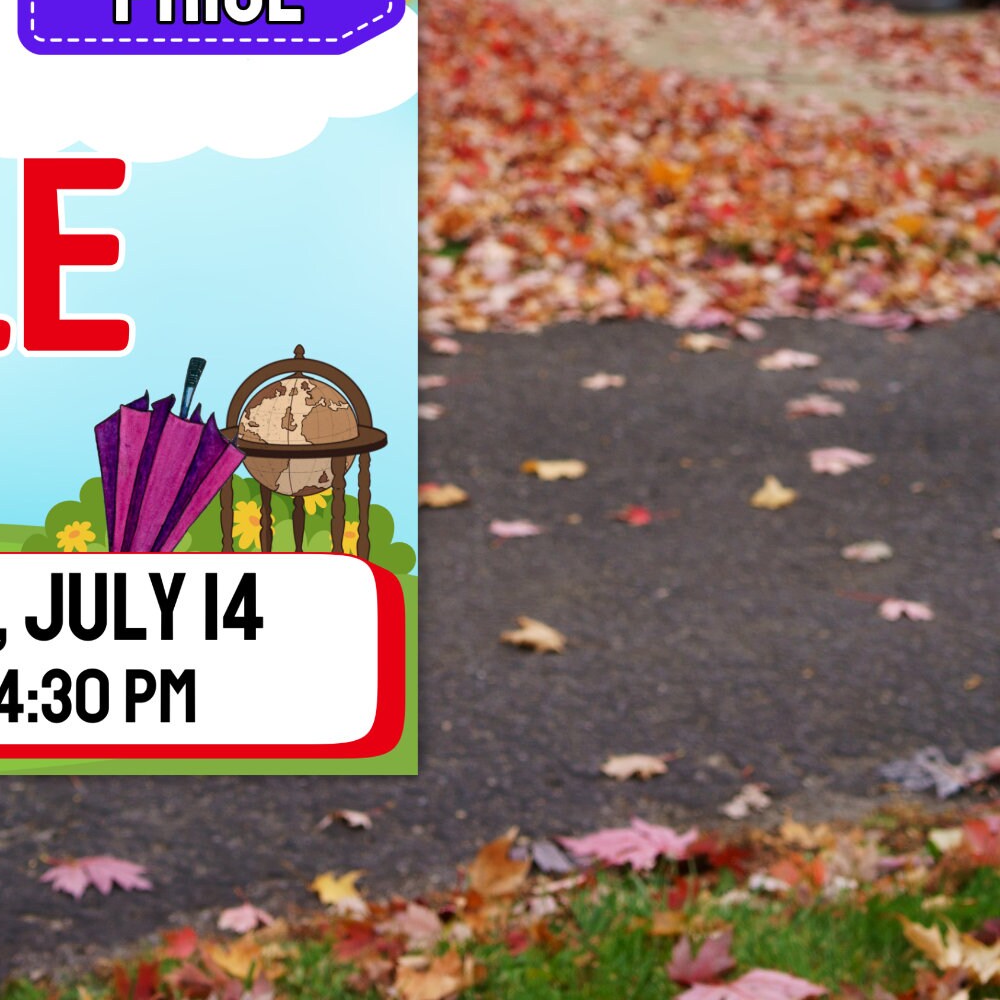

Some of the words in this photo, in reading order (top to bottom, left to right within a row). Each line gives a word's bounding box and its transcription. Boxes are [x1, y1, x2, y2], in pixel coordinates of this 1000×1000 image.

[25, 573, 185, 641] JULY
[206, 573, 263, 640] 14
[126, 669, 195, 722] PM
